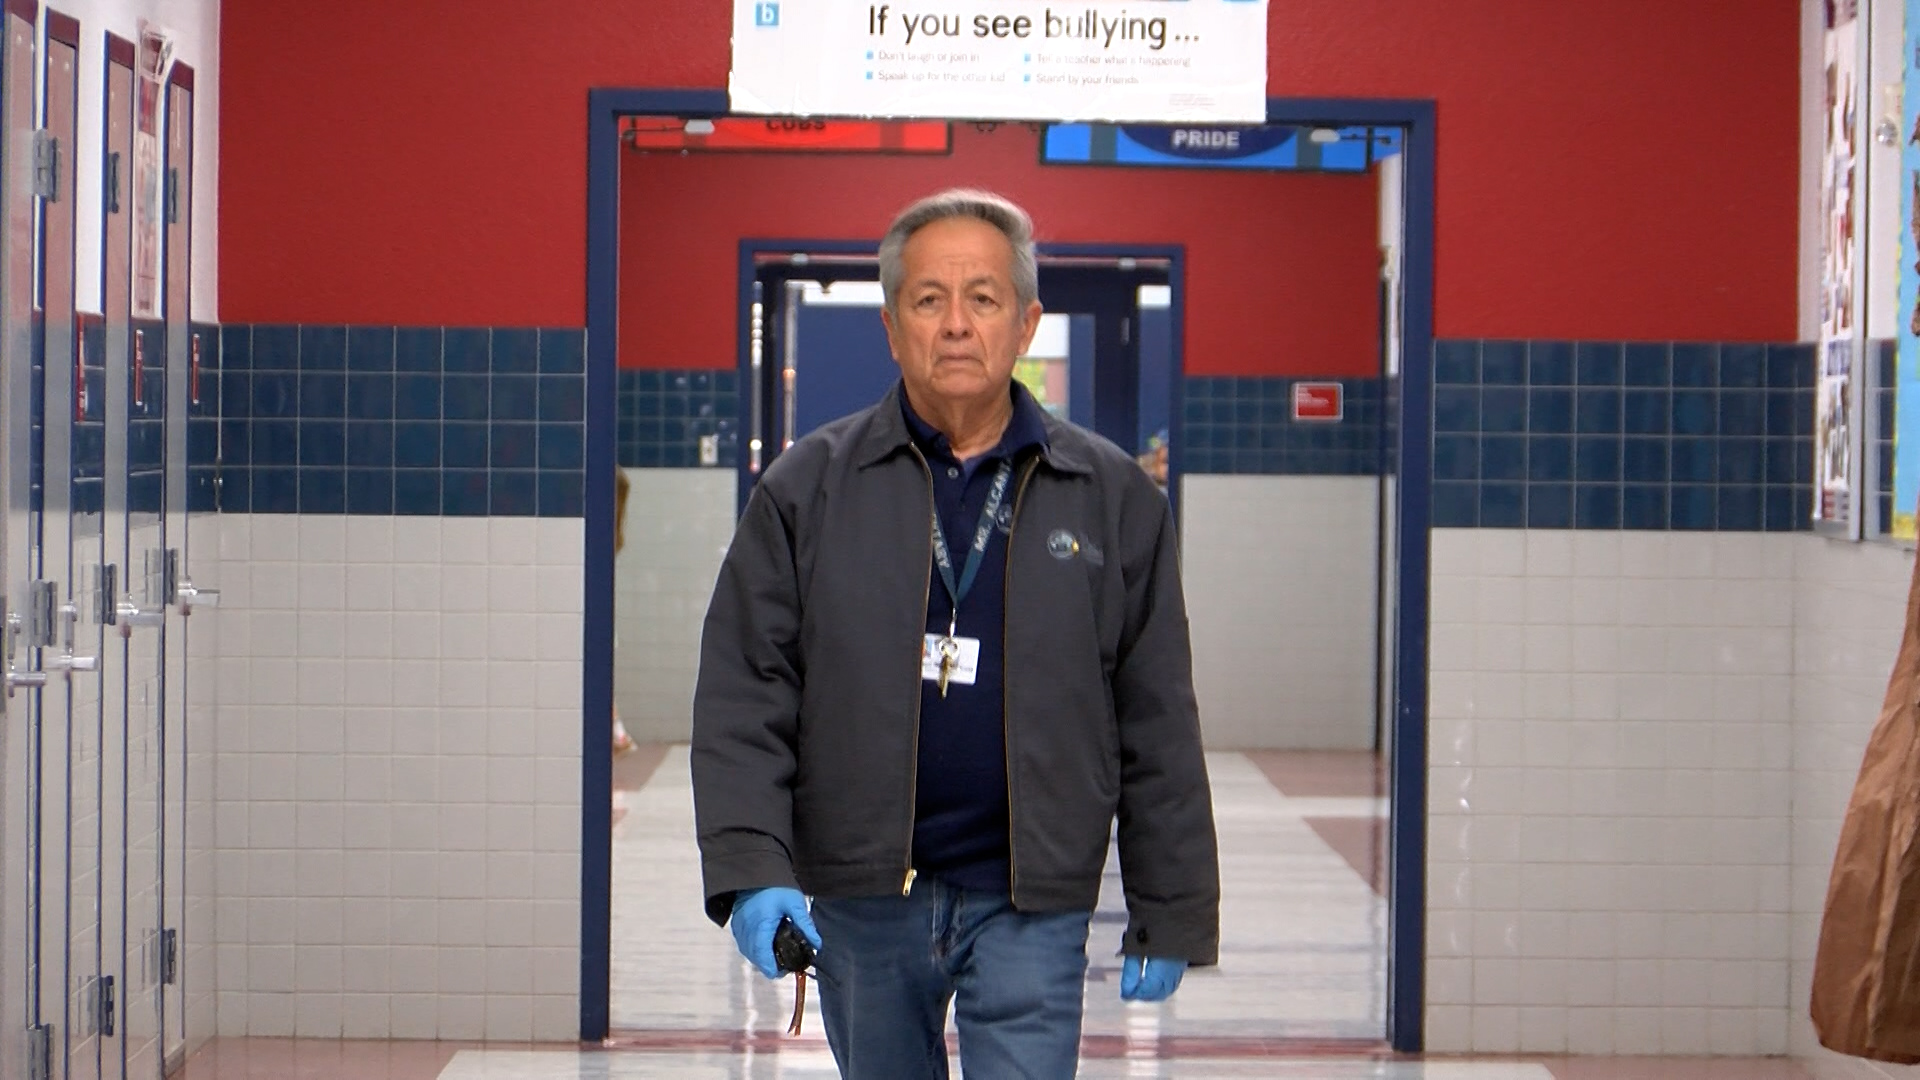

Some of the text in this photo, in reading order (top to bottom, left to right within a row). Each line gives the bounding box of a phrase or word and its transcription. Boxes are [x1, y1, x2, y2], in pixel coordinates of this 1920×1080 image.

[869, 5, 889, 35] If
[901, 13, 961, 45] you
[973, 14, 1032, 38] see
[1173, 129, 1239, 146] PRIDE
